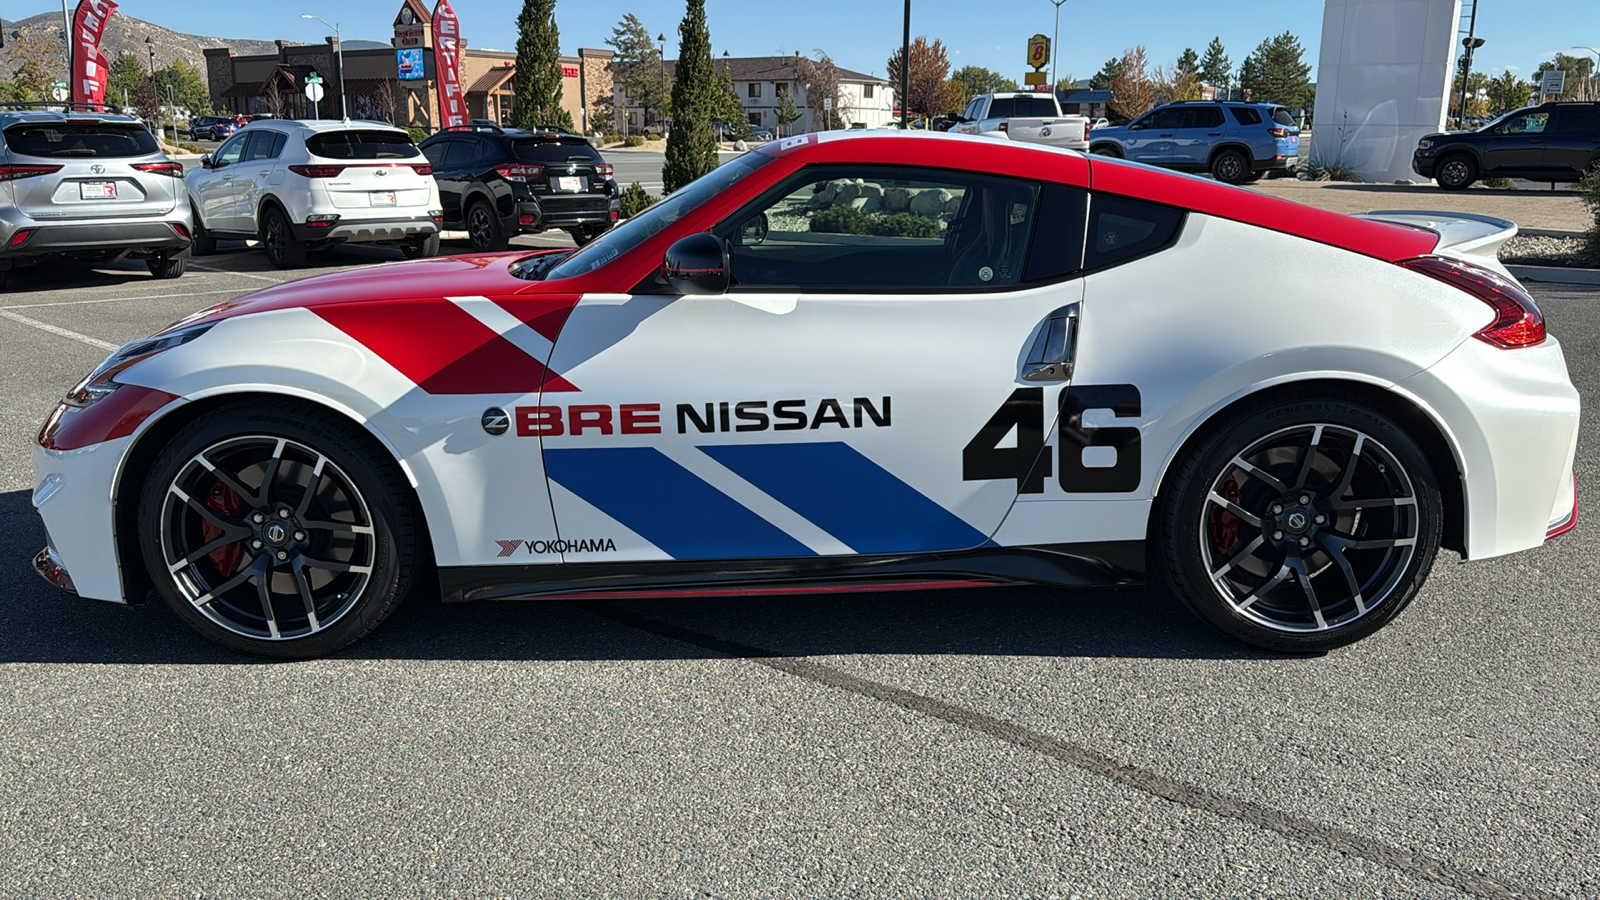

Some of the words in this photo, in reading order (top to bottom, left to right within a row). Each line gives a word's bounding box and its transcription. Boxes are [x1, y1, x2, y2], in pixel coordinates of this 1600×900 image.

[1032, 45, 1045, 61] 8
[515, 403, 662, 437] BRE
[676, 395, 892, 435] NISSAN
[963, 383, 1142, 494] 46
[524, 538, 617, 554] YOKOHAMA
